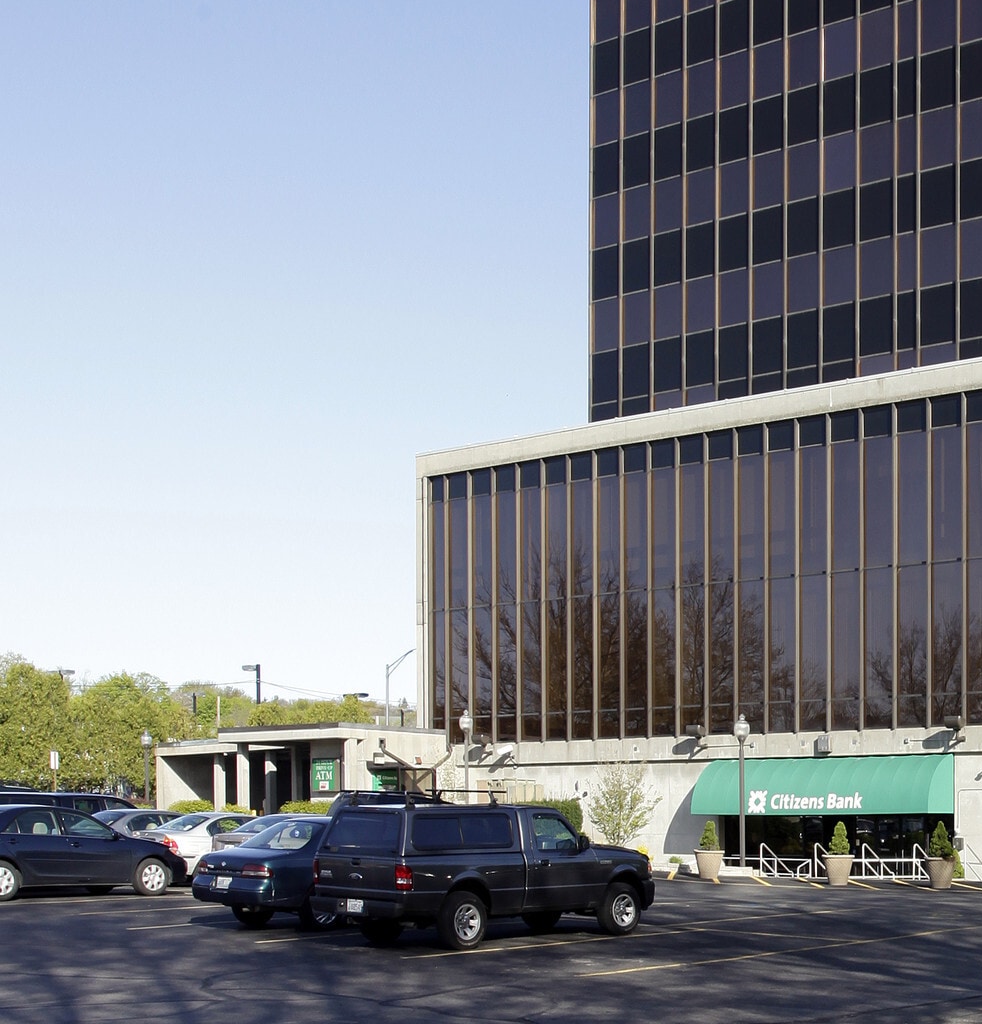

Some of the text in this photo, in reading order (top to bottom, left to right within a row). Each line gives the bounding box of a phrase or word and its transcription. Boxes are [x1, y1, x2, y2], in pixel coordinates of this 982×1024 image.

[315, 771, 333, 781] ATM
[770, 792, 863, 810] Citizens Bank
